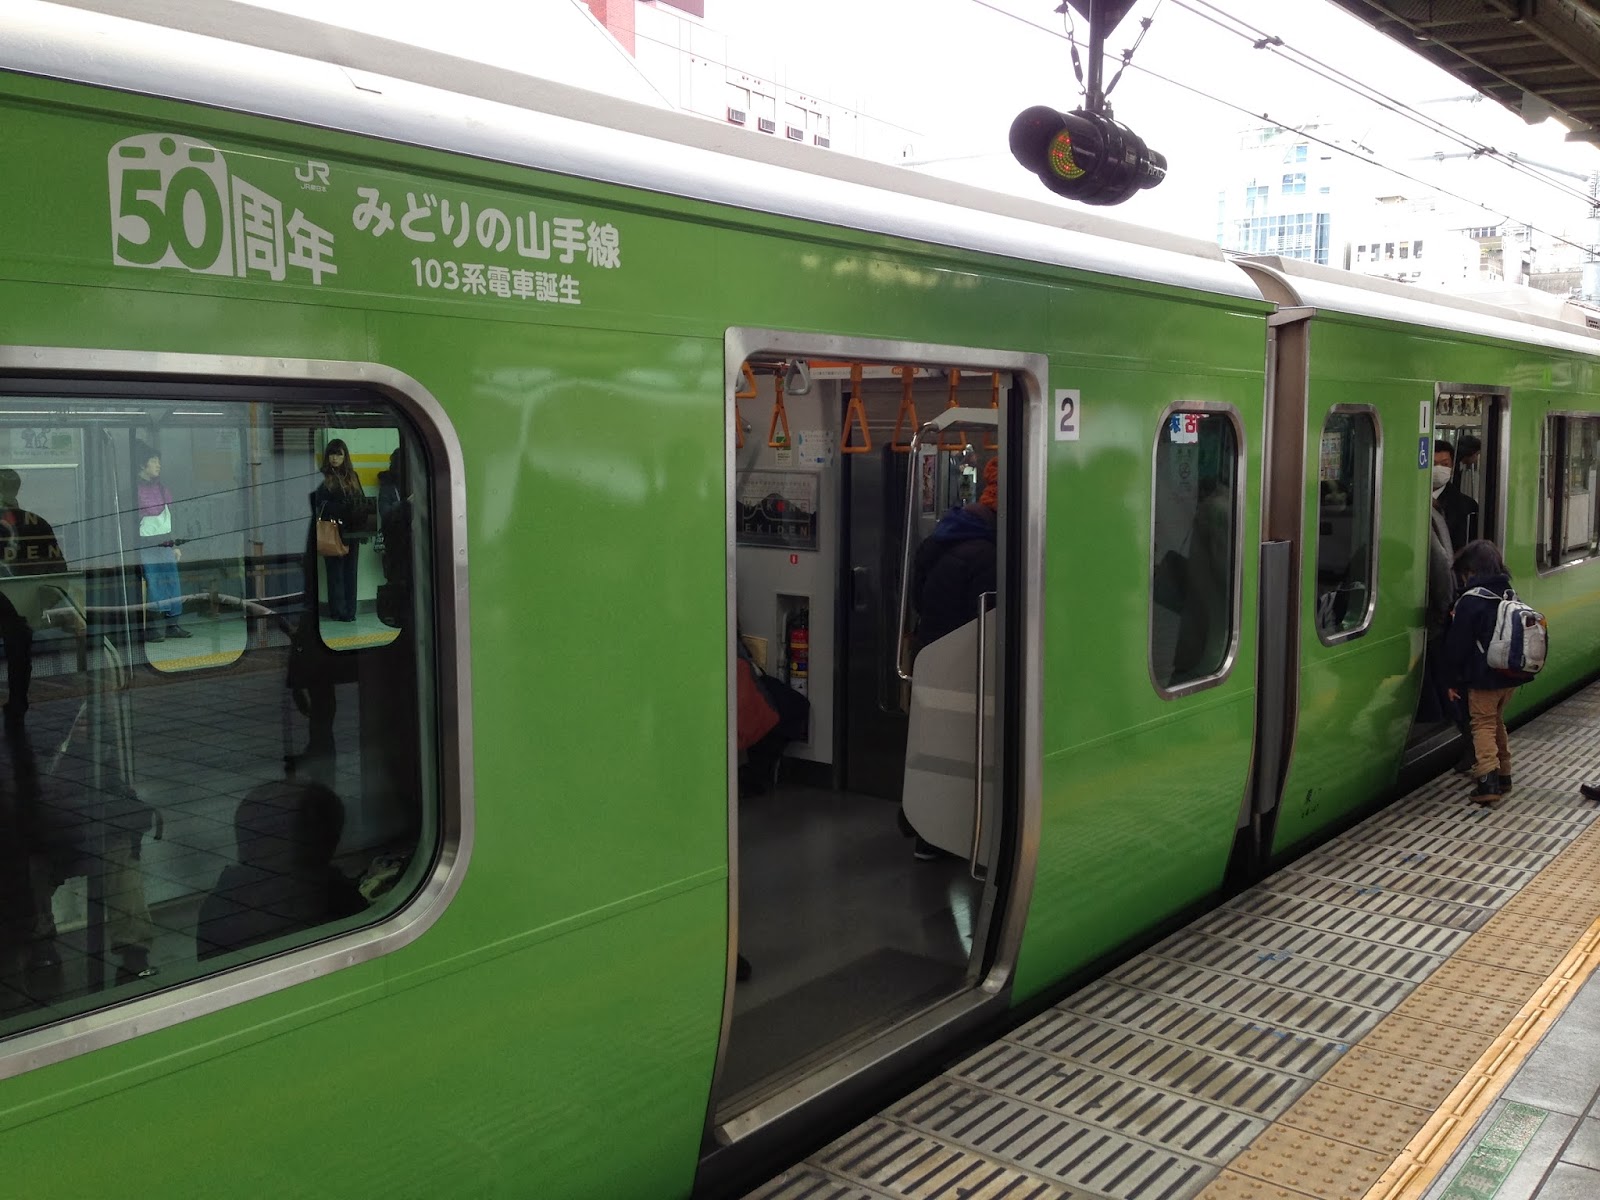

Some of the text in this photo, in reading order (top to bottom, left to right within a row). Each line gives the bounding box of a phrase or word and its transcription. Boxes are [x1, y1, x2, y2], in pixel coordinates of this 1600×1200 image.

[295, 160, 330, 185] JR
[352, 187, 621, 269] みどりの山手線
[410, 257, 582, 305] 103系電車誕生
[1060, 397, 1075, 432] 2
